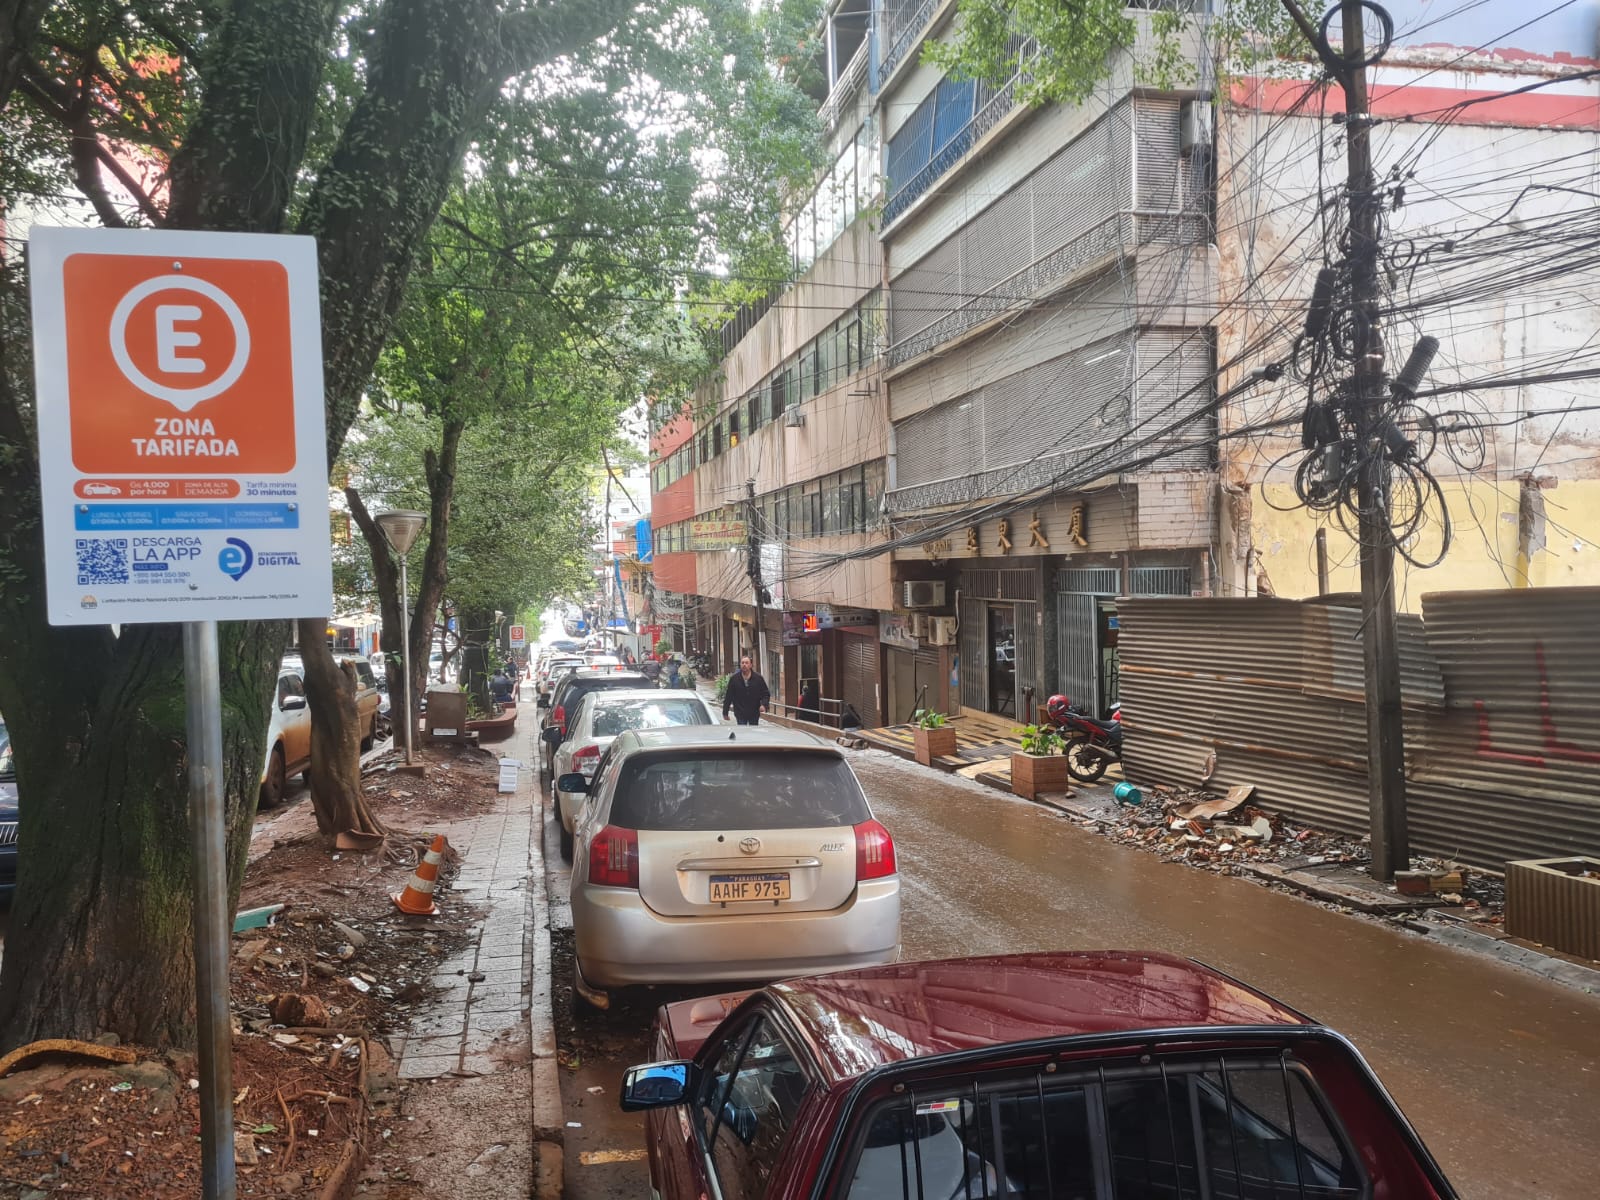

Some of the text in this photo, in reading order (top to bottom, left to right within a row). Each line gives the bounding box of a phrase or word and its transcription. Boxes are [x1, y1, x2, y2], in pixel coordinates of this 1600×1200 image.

[155, 305, 206, 373] E
[154, 418, 215, 437] ZONA
[131, 438, 239, 457] TARIFADA
[260, 488, 297, 496] minutos
[133, 537, 202, 547] DESCARGA
[133, 547, 202, 561] LA APP
[258, 557, 301, 566] DIGITAL
[713, 882, 781, 899] AAHF 975
